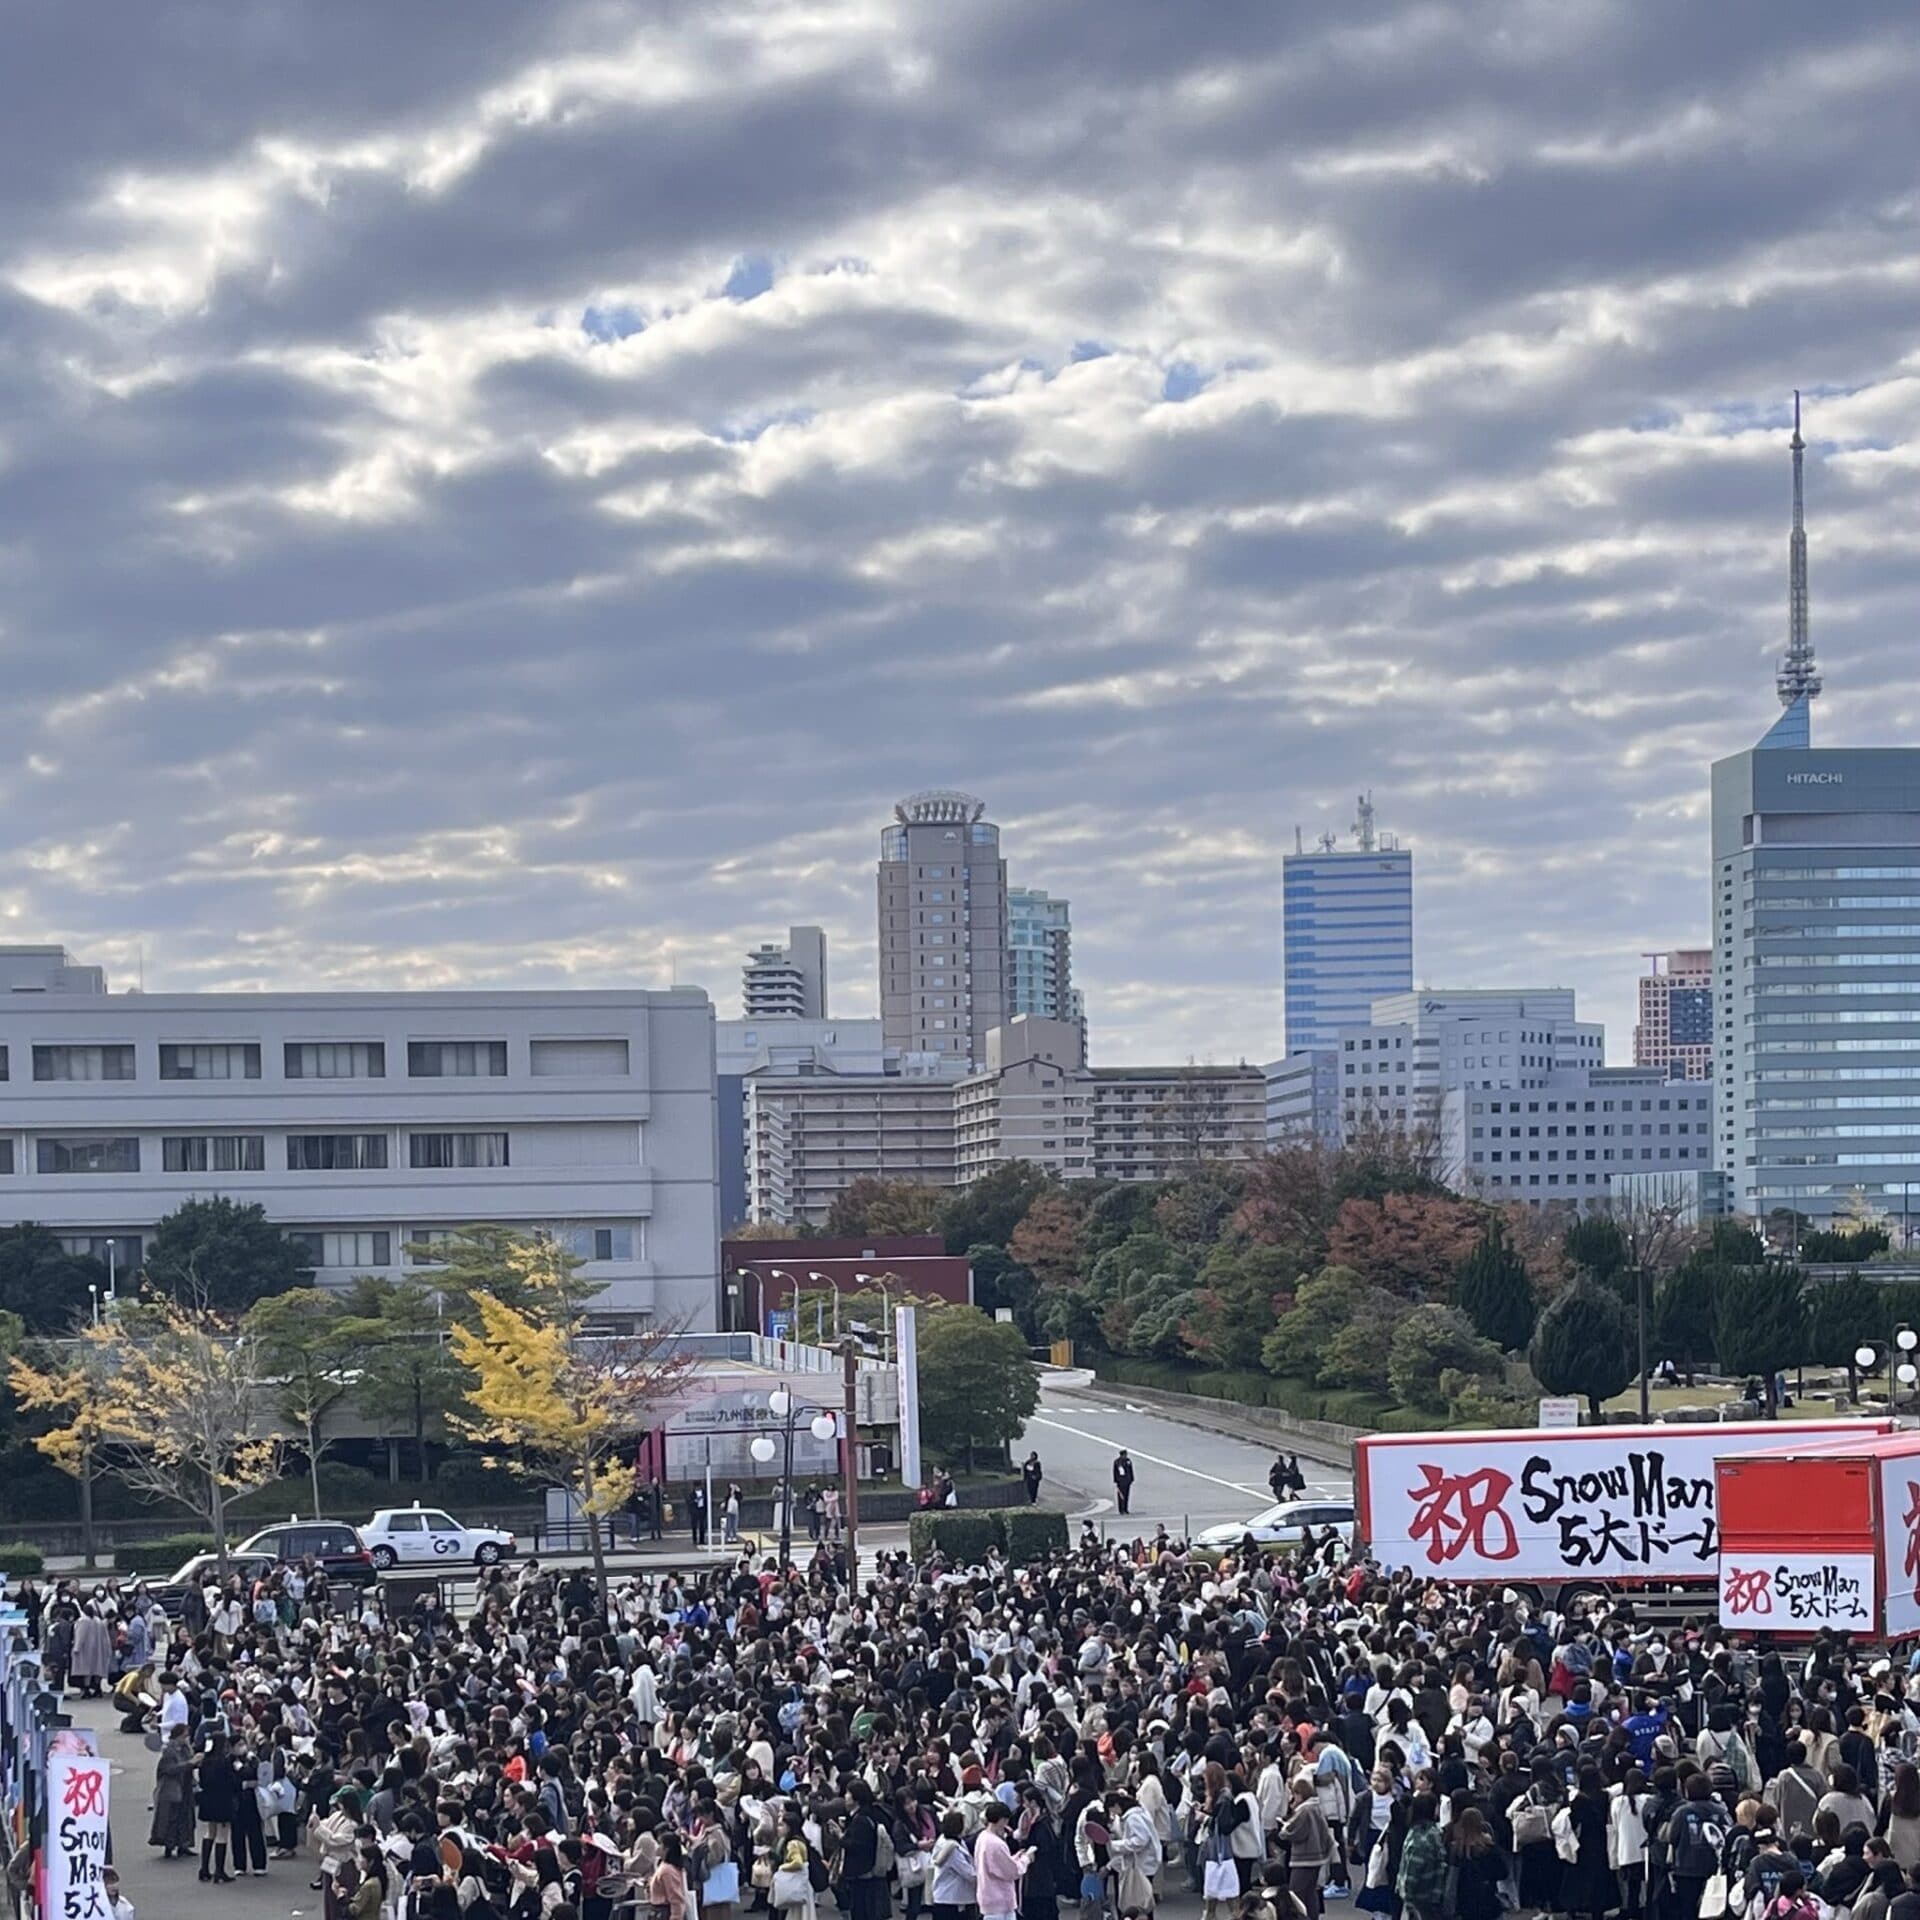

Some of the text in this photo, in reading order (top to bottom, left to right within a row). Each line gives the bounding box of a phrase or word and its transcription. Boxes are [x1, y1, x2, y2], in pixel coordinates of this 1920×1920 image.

[1786, 773, 1843, 784] HITACHI
[1520, 1451, 1713, 1523] Snow Man
[1407, 1464, 1520, 1565] 祝
[433, 1539, 460, 1554] GO
[1724, 1567, 1772, 1615] 祝
[1774, 1565, 1859, 1597] Snow Man
[1789, 1592, 1868, 1618] 5大ドーム
[63, 1767, 105, 1817] 祝
